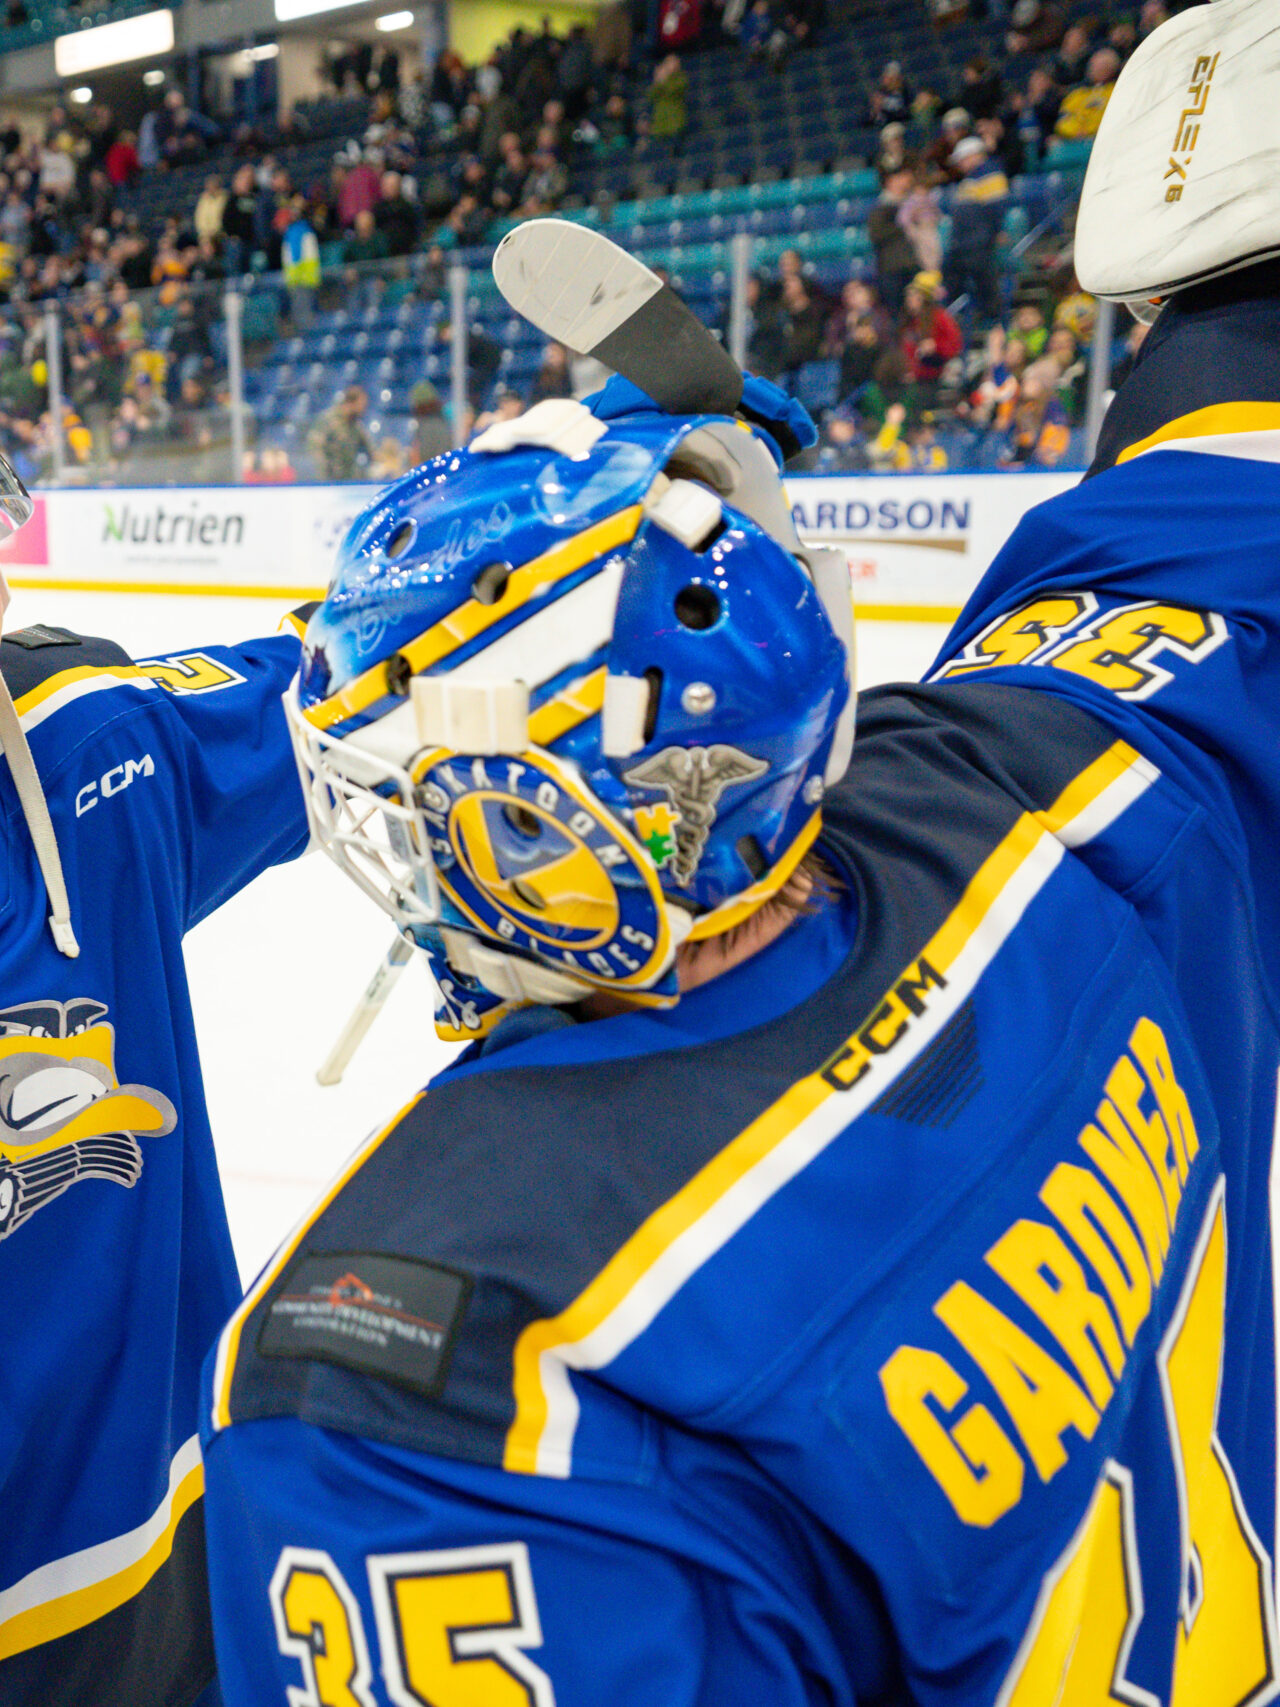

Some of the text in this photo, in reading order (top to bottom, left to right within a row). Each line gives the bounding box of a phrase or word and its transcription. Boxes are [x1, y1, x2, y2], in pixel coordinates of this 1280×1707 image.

[102, 501, 244, 545] Nutrien
[75, 753, 155, 818] CCM
[819, 957, 949, 1091] CCM
[878, 1015, 1201, 1529] GARDNER
